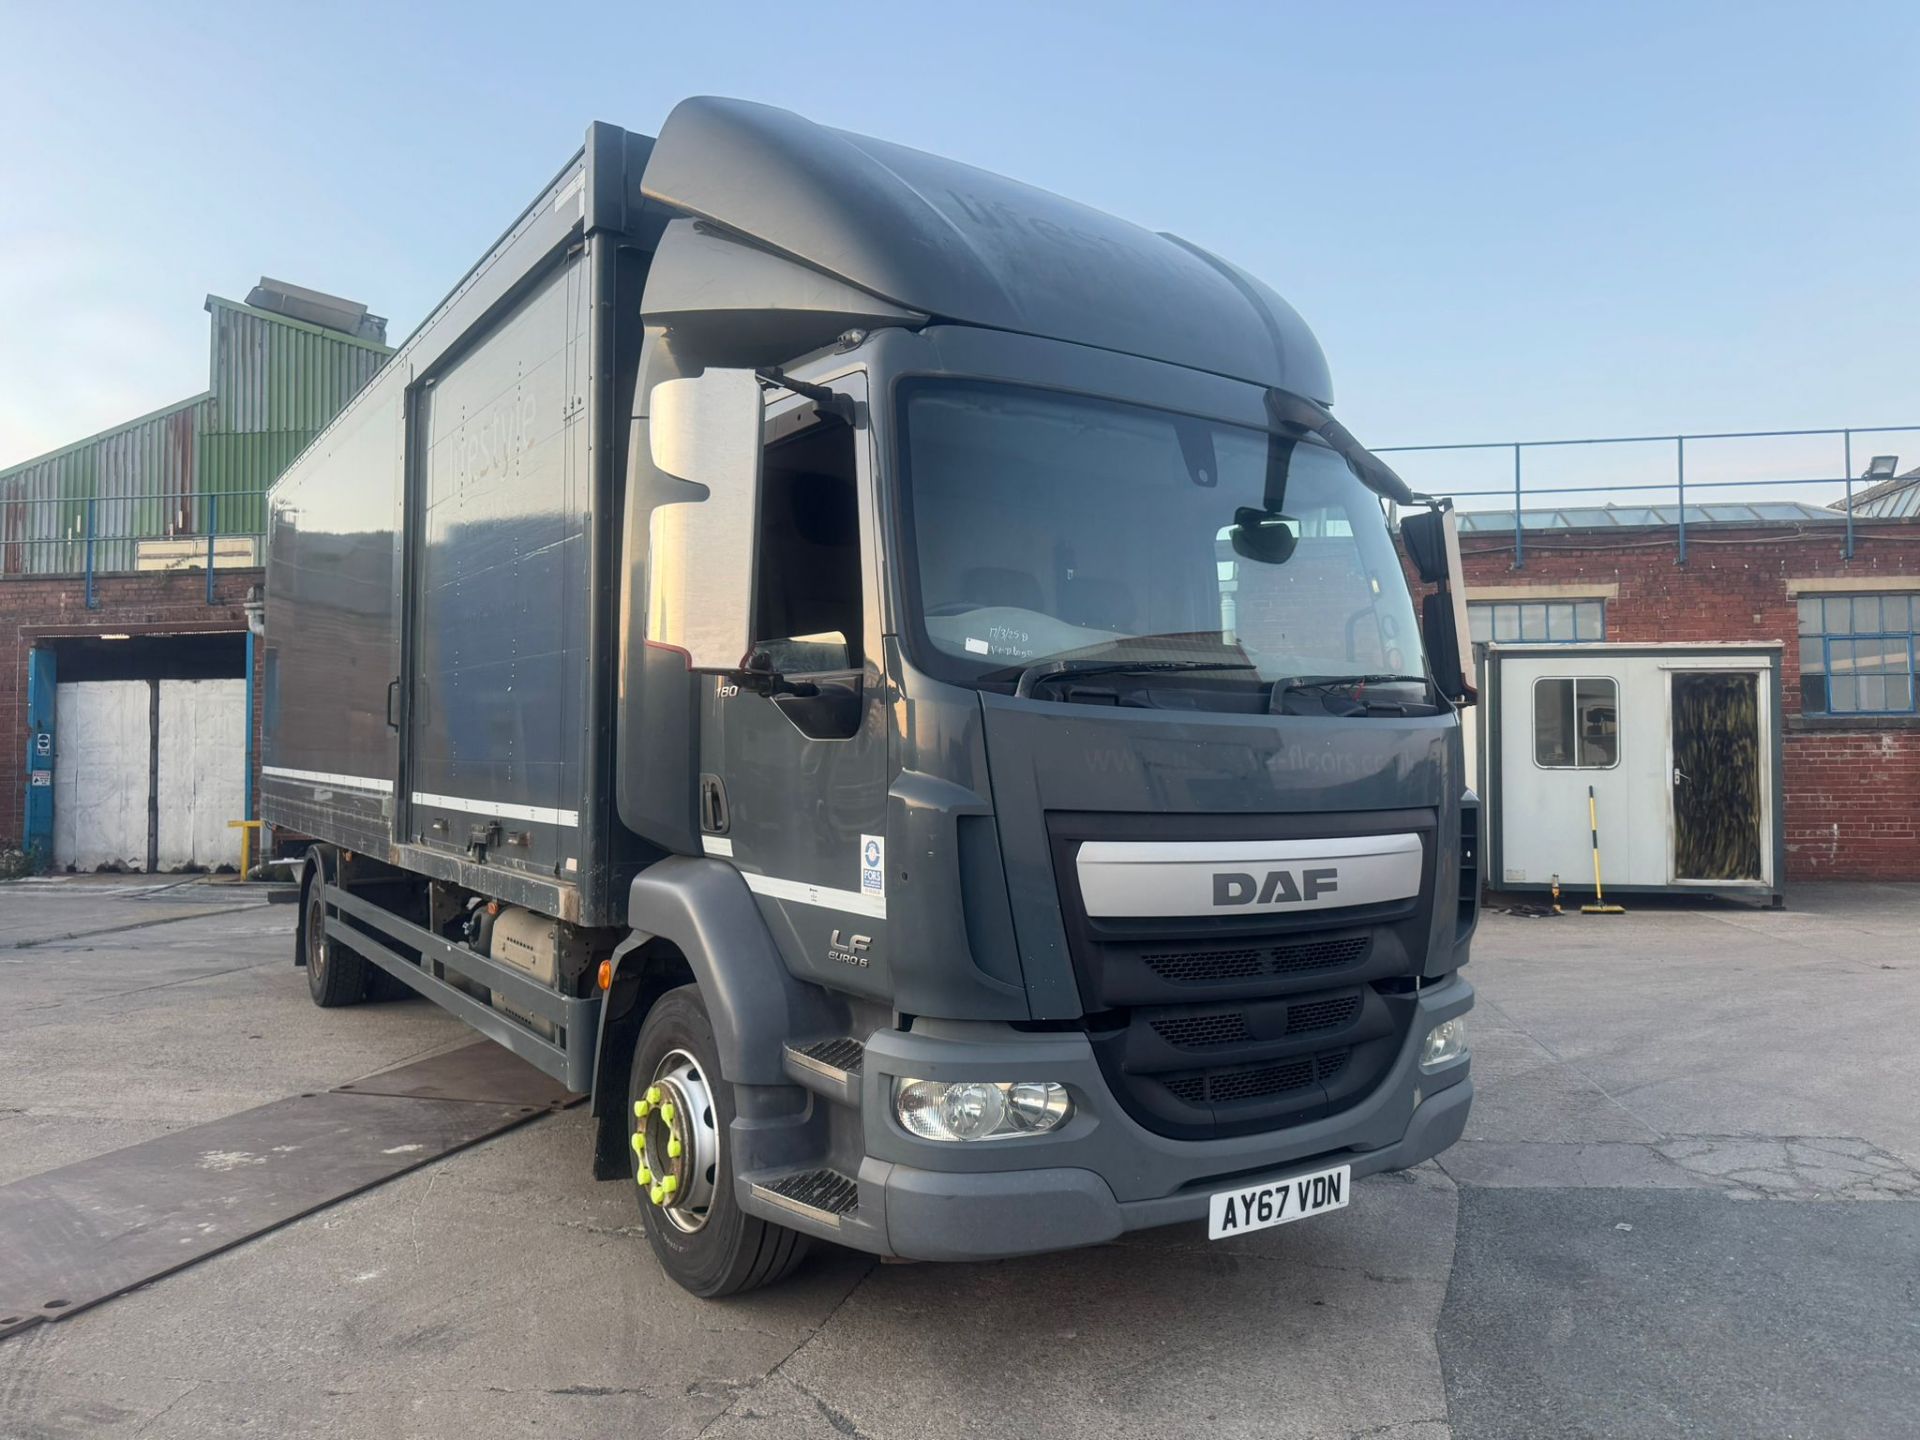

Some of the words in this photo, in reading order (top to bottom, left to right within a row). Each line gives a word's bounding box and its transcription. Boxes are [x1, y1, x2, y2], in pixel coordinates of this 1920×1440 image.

[716, 685, 738, 698] 180
[1212, 868, 1338, 906] DAF
[831, 929, 872, 954] LF
[828, 950, 858, 965] EURO
[860, 958, 869, 968] 6
[1222, 1185, 1290, 1231] AY67
[1298, 1172, 1342, 1212] VDN
